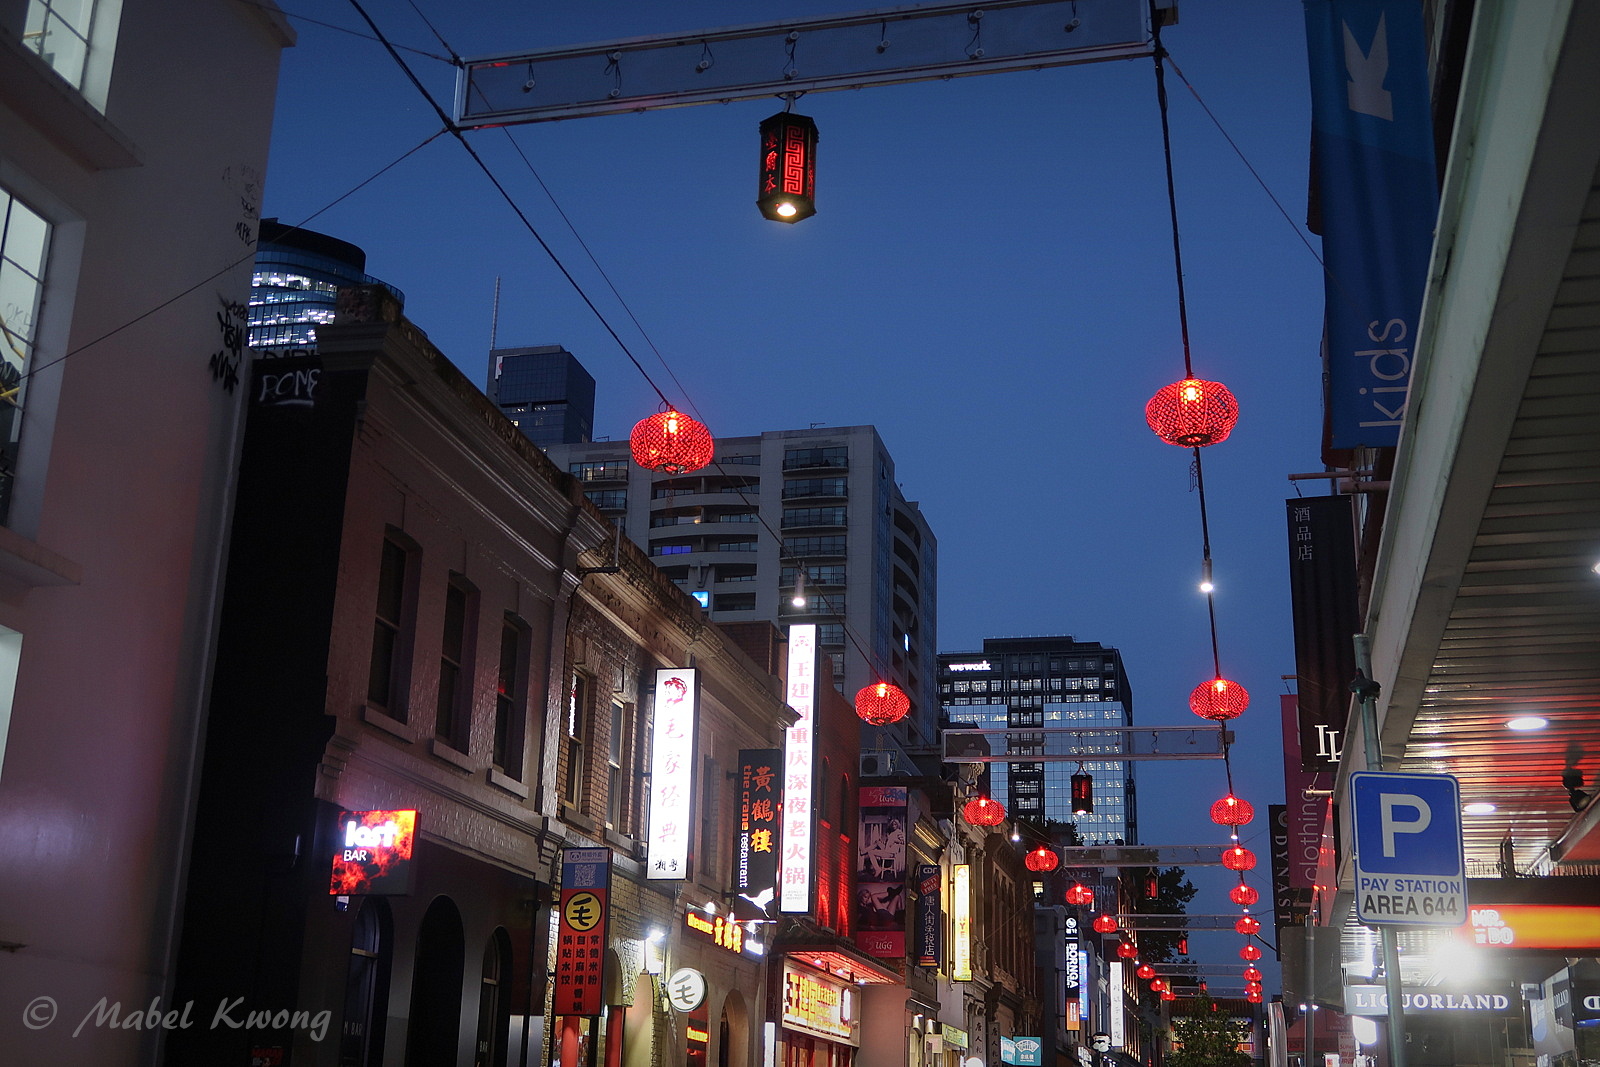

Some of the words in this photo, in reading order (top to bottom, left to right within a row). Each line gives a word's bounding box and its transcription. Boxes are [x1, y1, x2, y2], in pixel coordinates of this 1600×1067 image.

[1354, 318, 1410, 428] kids
[1294, 506, 1313, 561] 酒品店
[949, 660, 991, 671] wework
[742, 766, 752, 788] the
[741, 791, 750, 831] crane
[1380, 793, 1432, 857] P
[344, 849, 367, 861] BAR
[739, 832, 749, 888] restaurant
[1361, 878, 1389, 891] PAY
[1395, 878, 1461, 894] STATION
[570, 896, 593, 926] 毛
[1363, 894, 1419, 915] AREA
[1422, 896, 1458, 916] 644
[875, 941, 893, 949] UGG
[1068, 942, 1079, 989] BORNGA
[674, 974, 696, 1005] 毛
